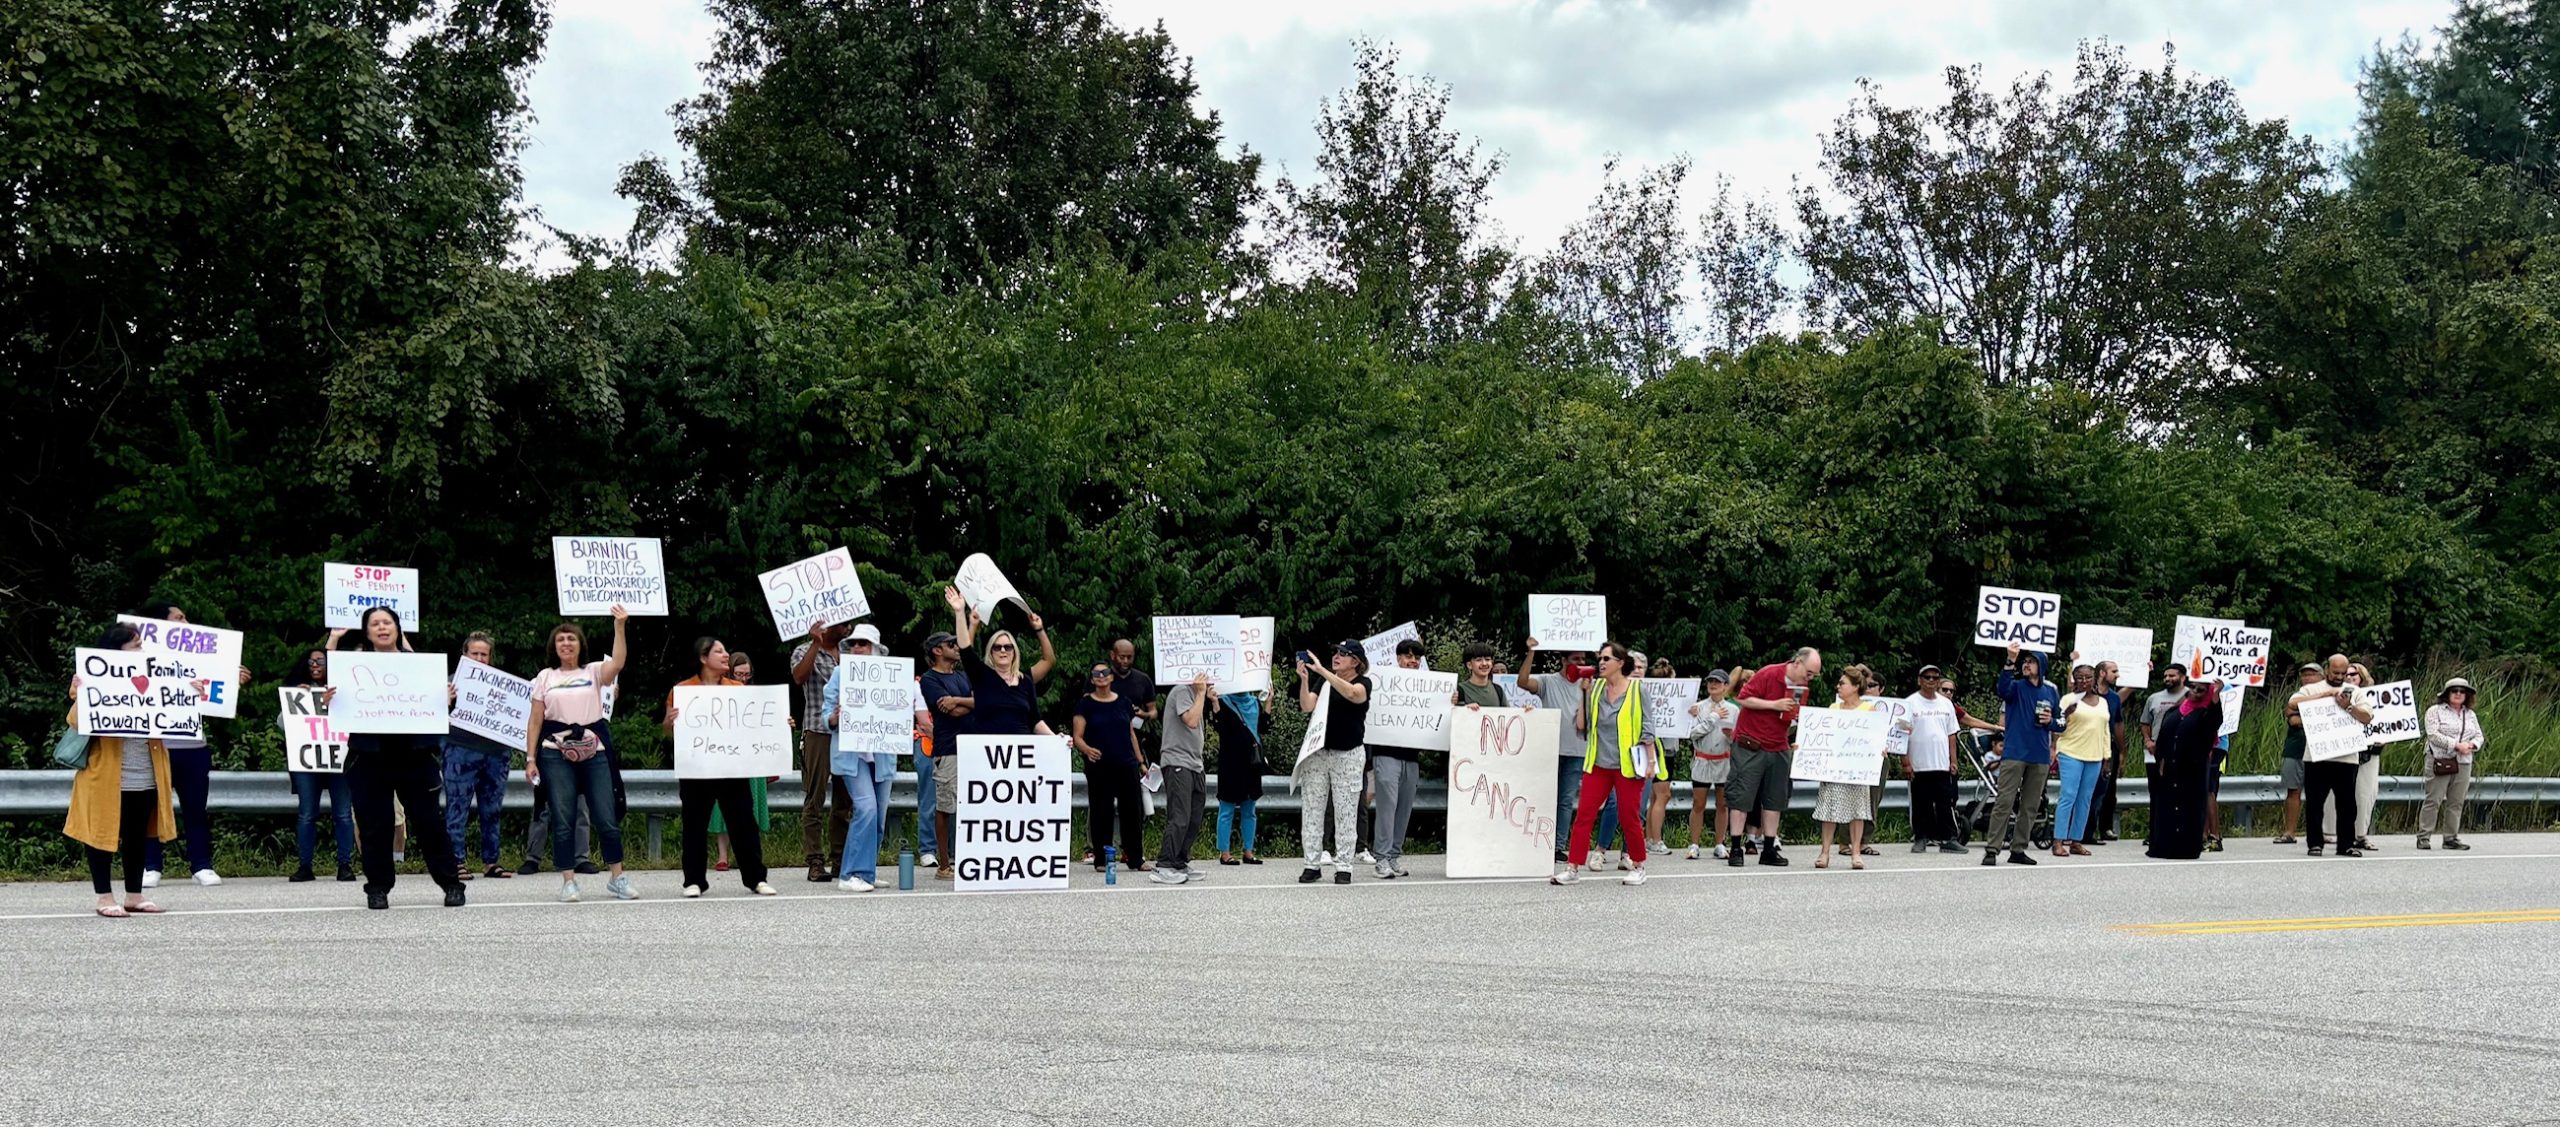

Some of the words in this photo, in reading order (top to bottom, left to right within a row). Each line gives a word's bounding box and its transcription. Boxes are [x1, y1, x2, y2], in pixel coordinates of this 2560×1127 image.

[571, 540, 638, 560] BURNING
[354, 567, 391, 581] STOP
[587, 560, 646, 576] PLASTICS
[338, 578, 360, 589] THE
[368, 581, 405, 593] PERMIT!
[595, 576, 661, 591] DANGEROUS
[769, 555, 844, 604] STOP
[349, 594, 398, 609] PROTECT
[565, 590, 580, 603] TO
[1984, 594, 2056, 619] STOP
[328, 606, 349, 617] THE
[1547, 597, 1597, 618] GRACE
[1158, 617, 1213, 630] BURNING
[1551, 617, 1584, 630] STOP
[1976, 619, 2056, 646] GRACE
[1559, 630, 1596, 641] PERMIT
[2202, 626, 2232, 645] W.R.
[2236, 630, 2269, 646] Grace
[85, 655, 137, 678] Our
[147, 657, 197, 679] Families
[1165, 652, 1196, 667] STOP
[1202, 652, 1222, 664] WR
[2202, 656, 2265, 680] Disgrace
[850, 661, 902, 683] NOT
[1371, 672, 1402, 693] OUR
[1405, 677, 1457, 694] CHILDREN
[1645, 681, 1687, 698] TENCIAL
[87, 686, 156, 708] Deserve
[160, 686, 200, 708] Better
[466, 692, 485, 706] BIG
[486, 699, 522, 719] SOURCE
[487, 688, 507, 704] ARE
[845, 687, 867, 704] IN
[871, 688, 909, 708] OUR
[1379, 693, 1431, 709] DESERVE
[90, 711, 150, 731] Howard
[1364, 713, 1407, 728] CLEAN
[1411, 714, 1443, 731] AIR!
[1804, 713, 1833, 731] WE
[1837, 717, 1870, 730] WILL
[1480, 714, 1526, 756] NO
[1802, 732, 1835, 748] NOT
[299, 744, 342, 770] CLE
[692, 737, 741, 758] Please
[984, 745, 1036, 770] WE
[967, 775, 1064, 804] DON'T
[1453, 757, 1555, 850] CANCER
[960, 819, 1070, 843] TRUST
[958, 855, 1068, 881] GRACE
